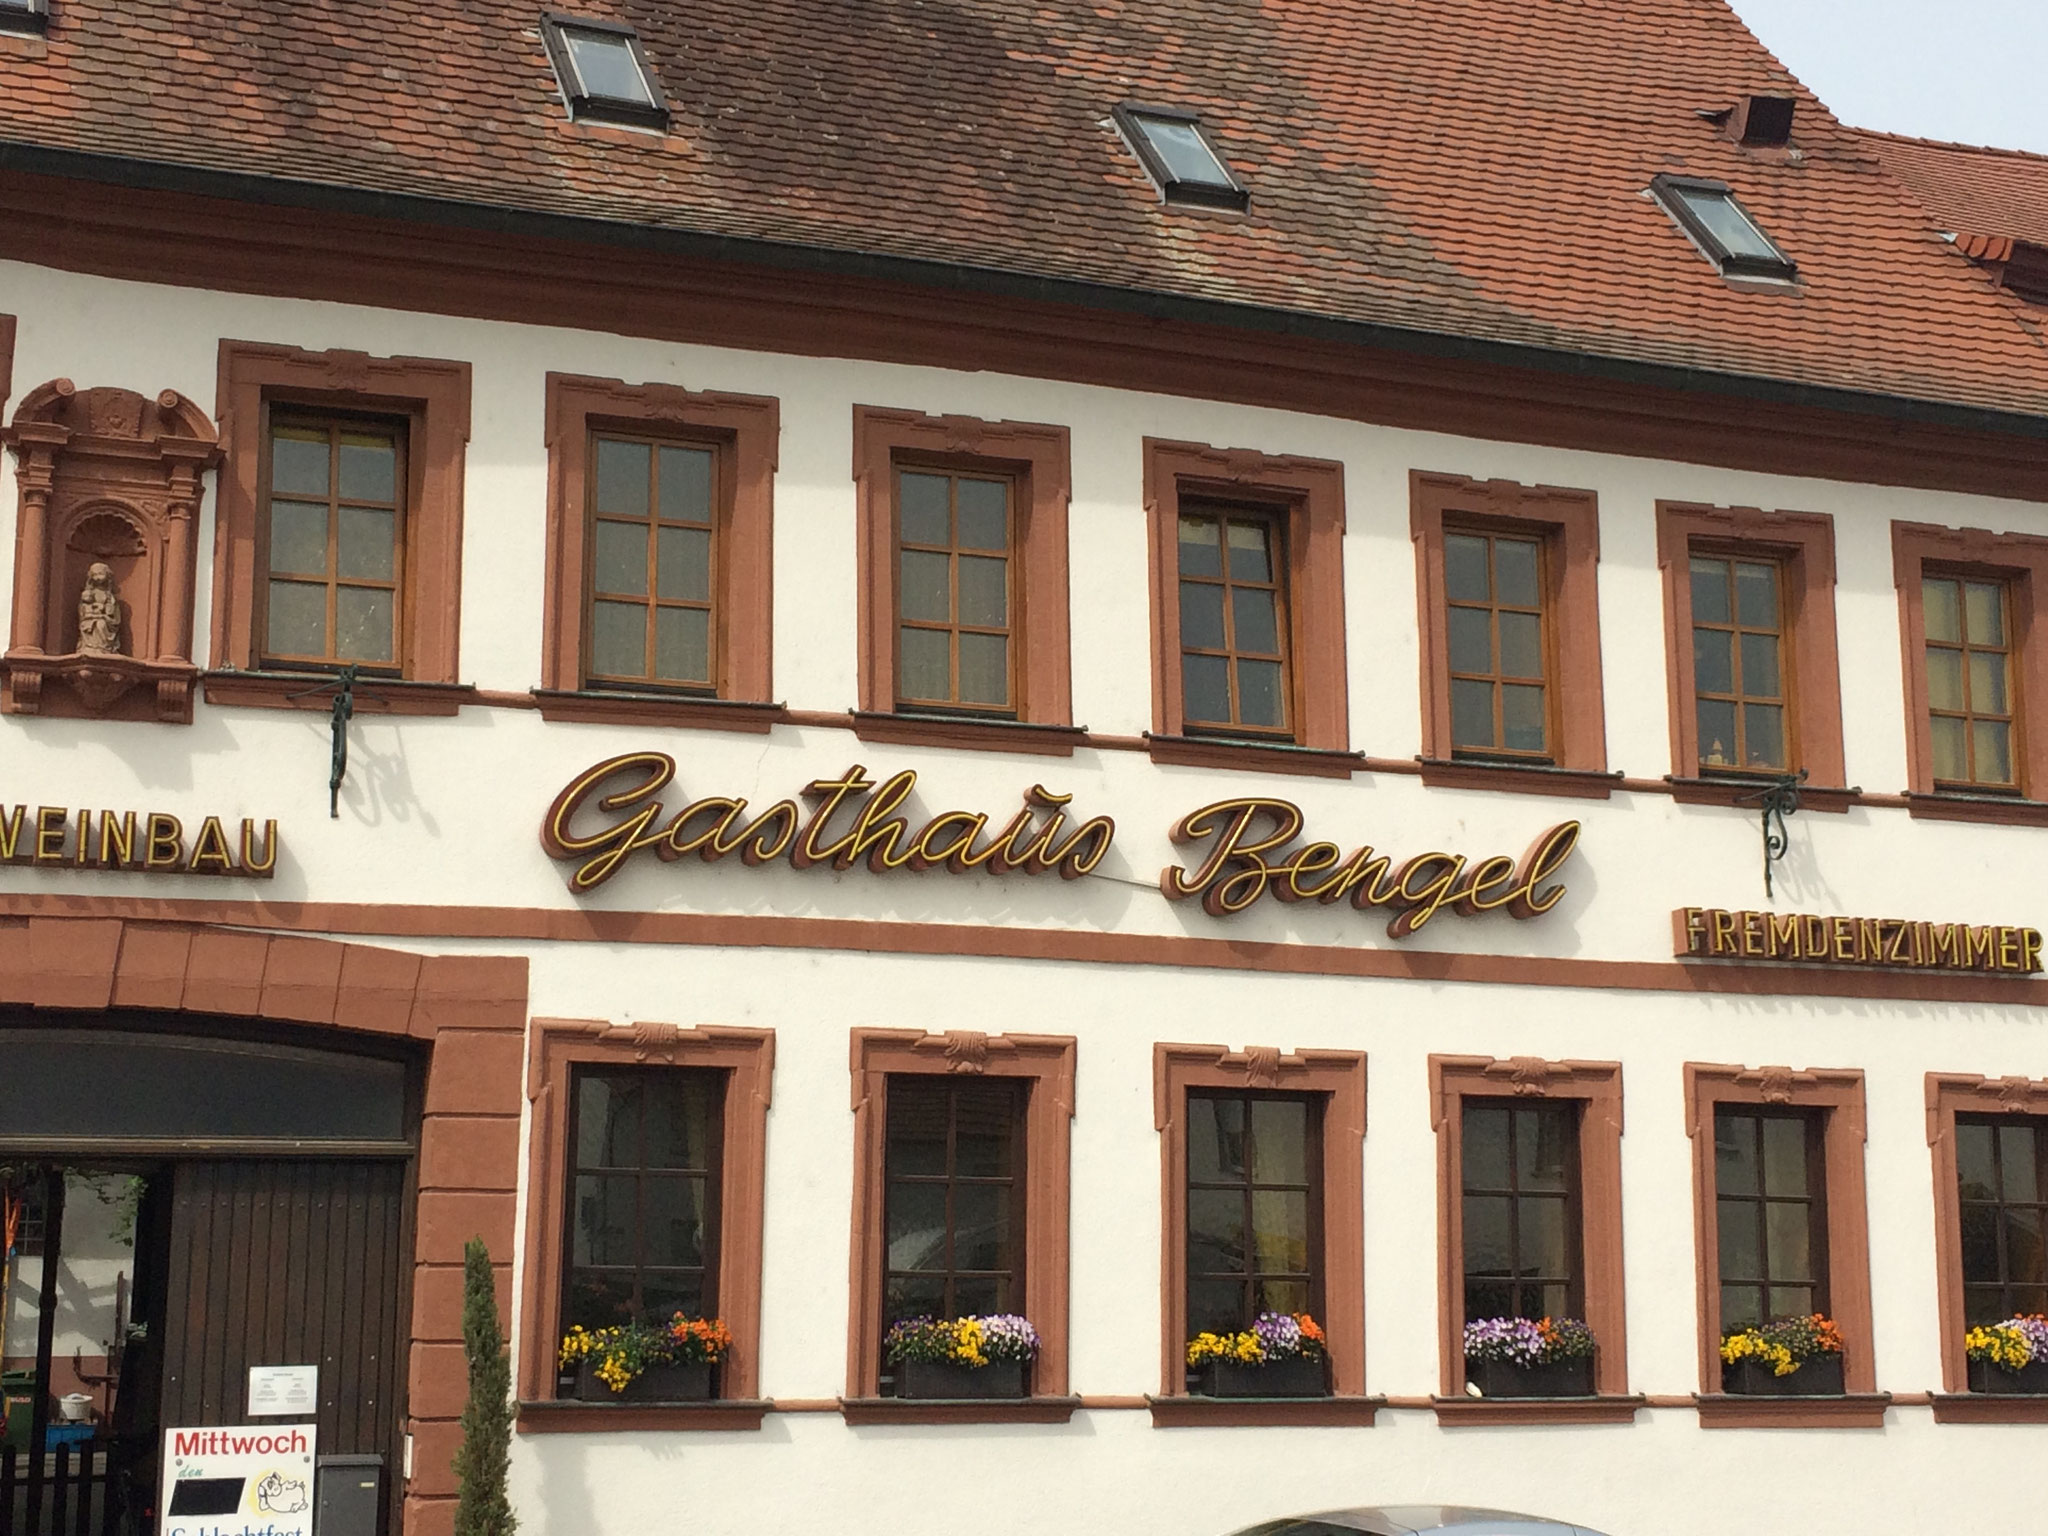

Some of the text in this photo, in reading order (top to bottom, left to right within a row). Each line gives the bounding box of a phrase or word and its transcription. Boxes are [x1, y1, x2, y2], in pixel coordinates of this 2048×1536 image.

[540, 751, 1581, 939] Gasthaus Bengel
[1673, 907, 2044, 974] FREMDENZIMMER
[174, 1429, 307, 1456] Mittwoch
[178, 1465, 203, 1478] den
